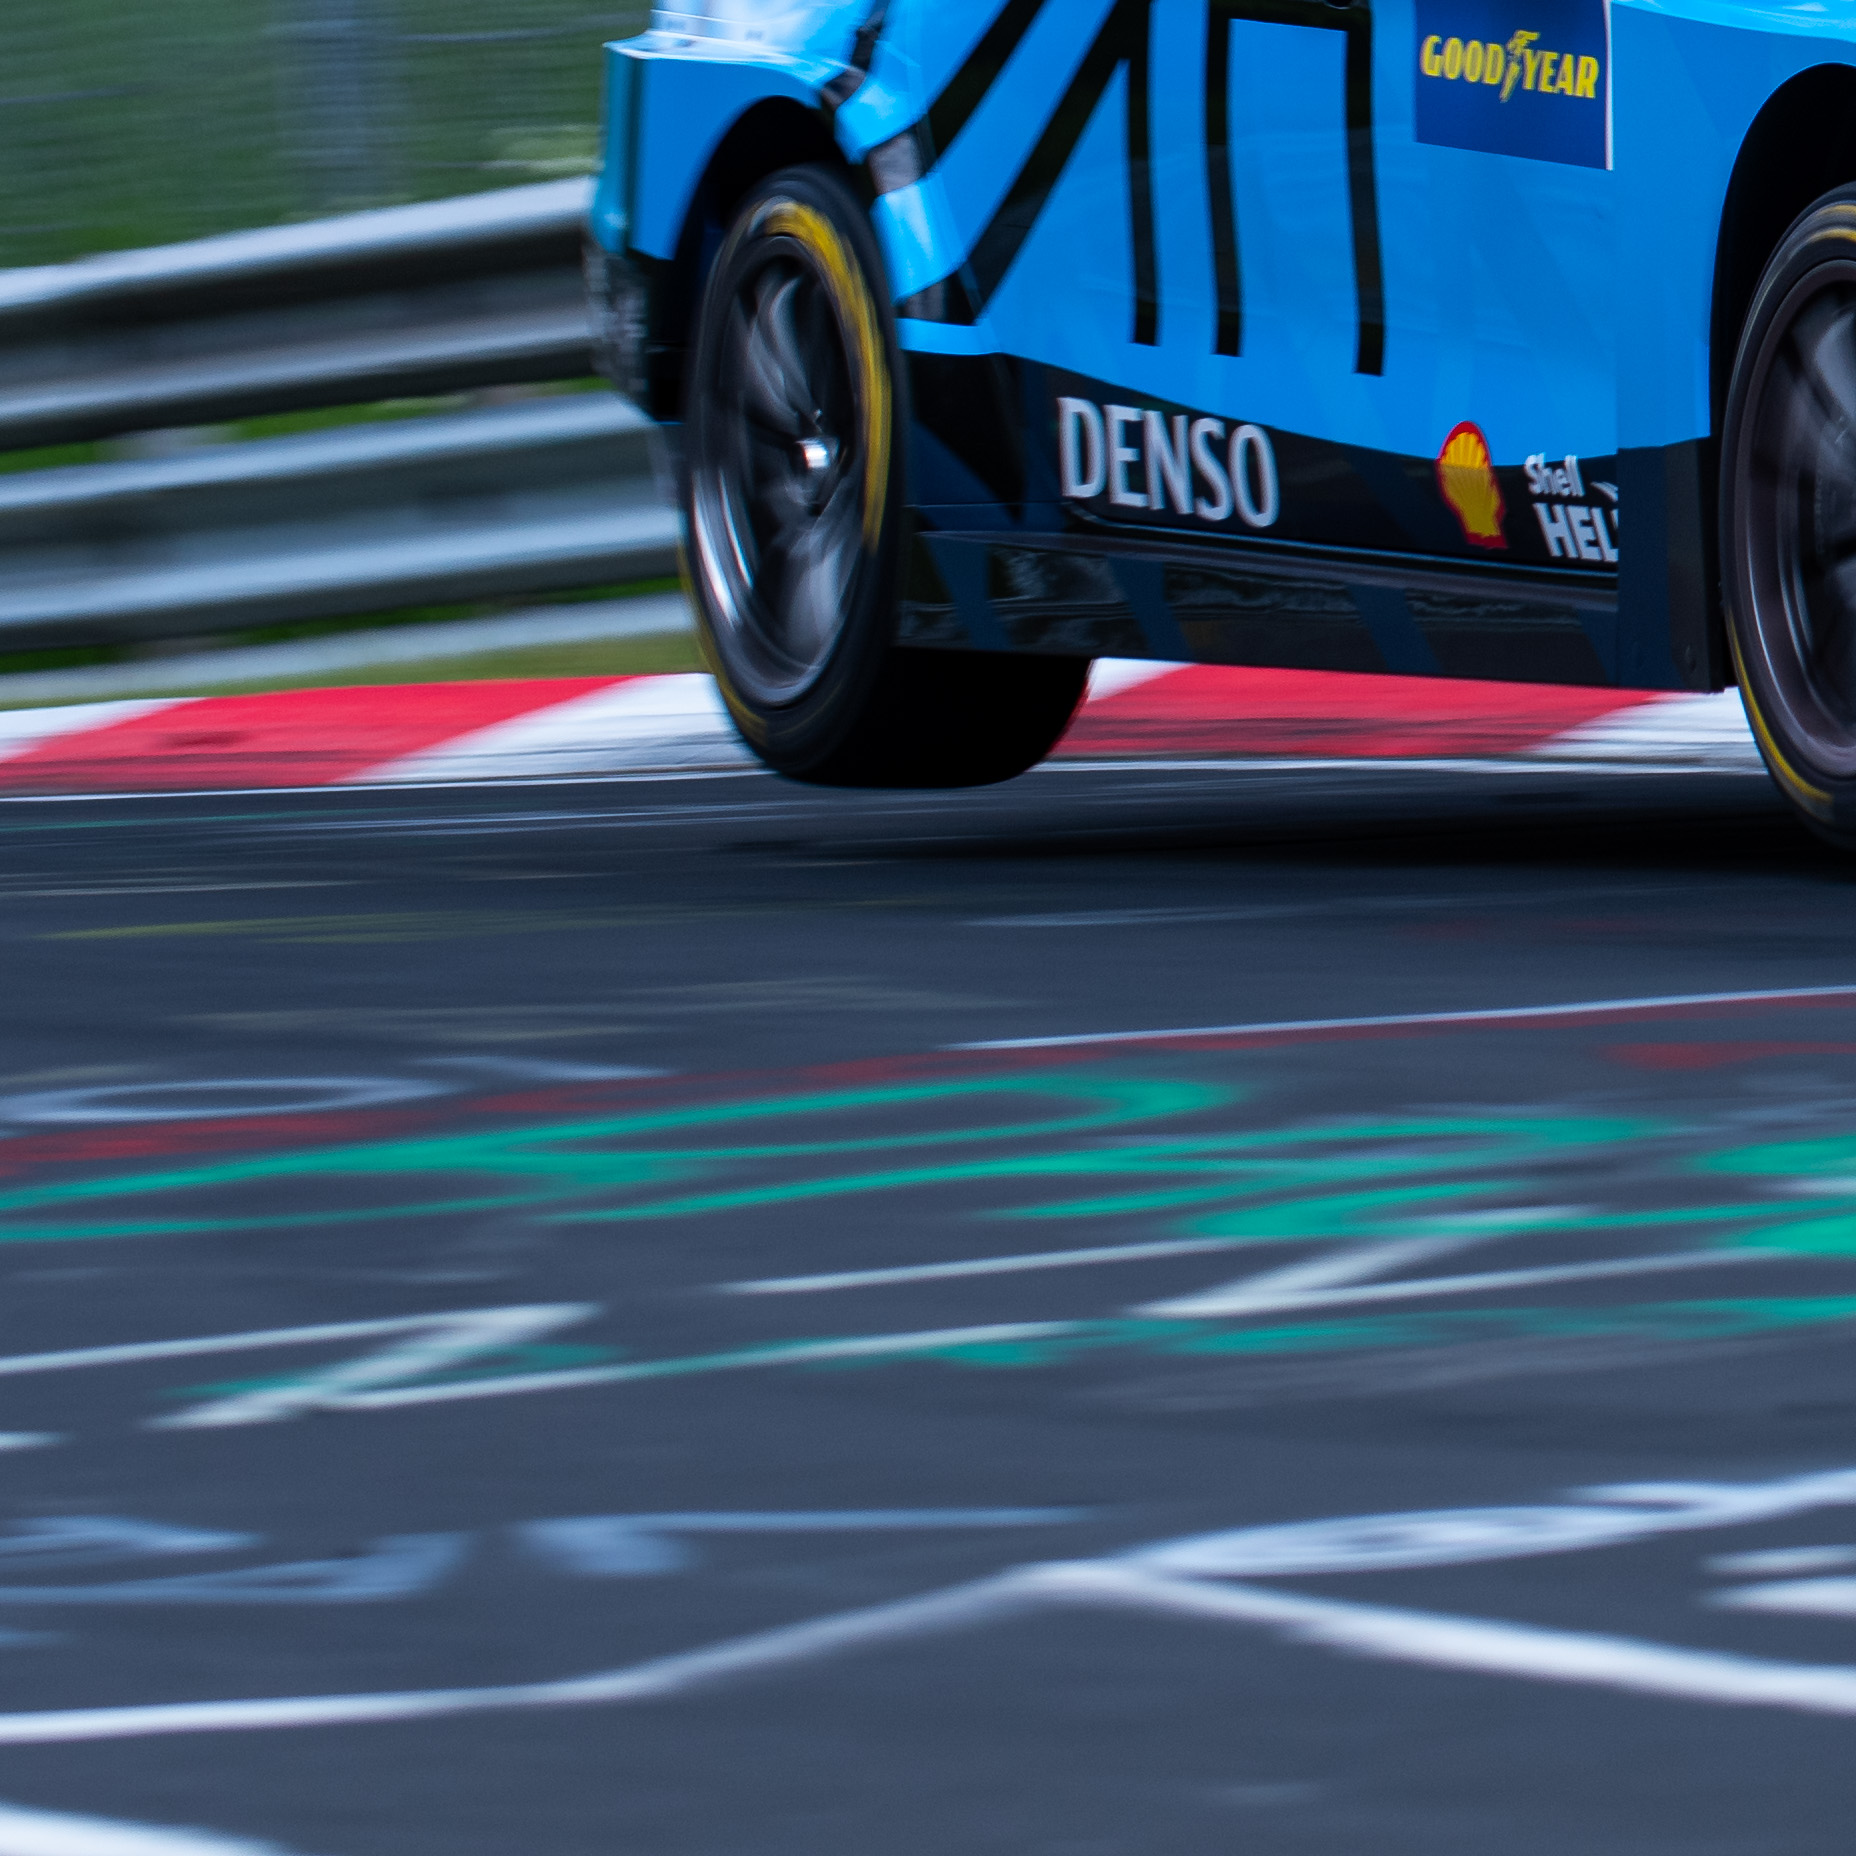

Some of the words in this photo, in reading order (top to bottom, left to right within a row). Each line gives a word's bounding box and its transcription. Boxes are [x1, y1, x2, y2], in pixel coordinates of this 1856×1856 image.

[1419, 30, 1600, 102] GOODYEAR
[1056, 396, 1280, 528] DENSO
[1524, 452, 1586, 497] Shell
